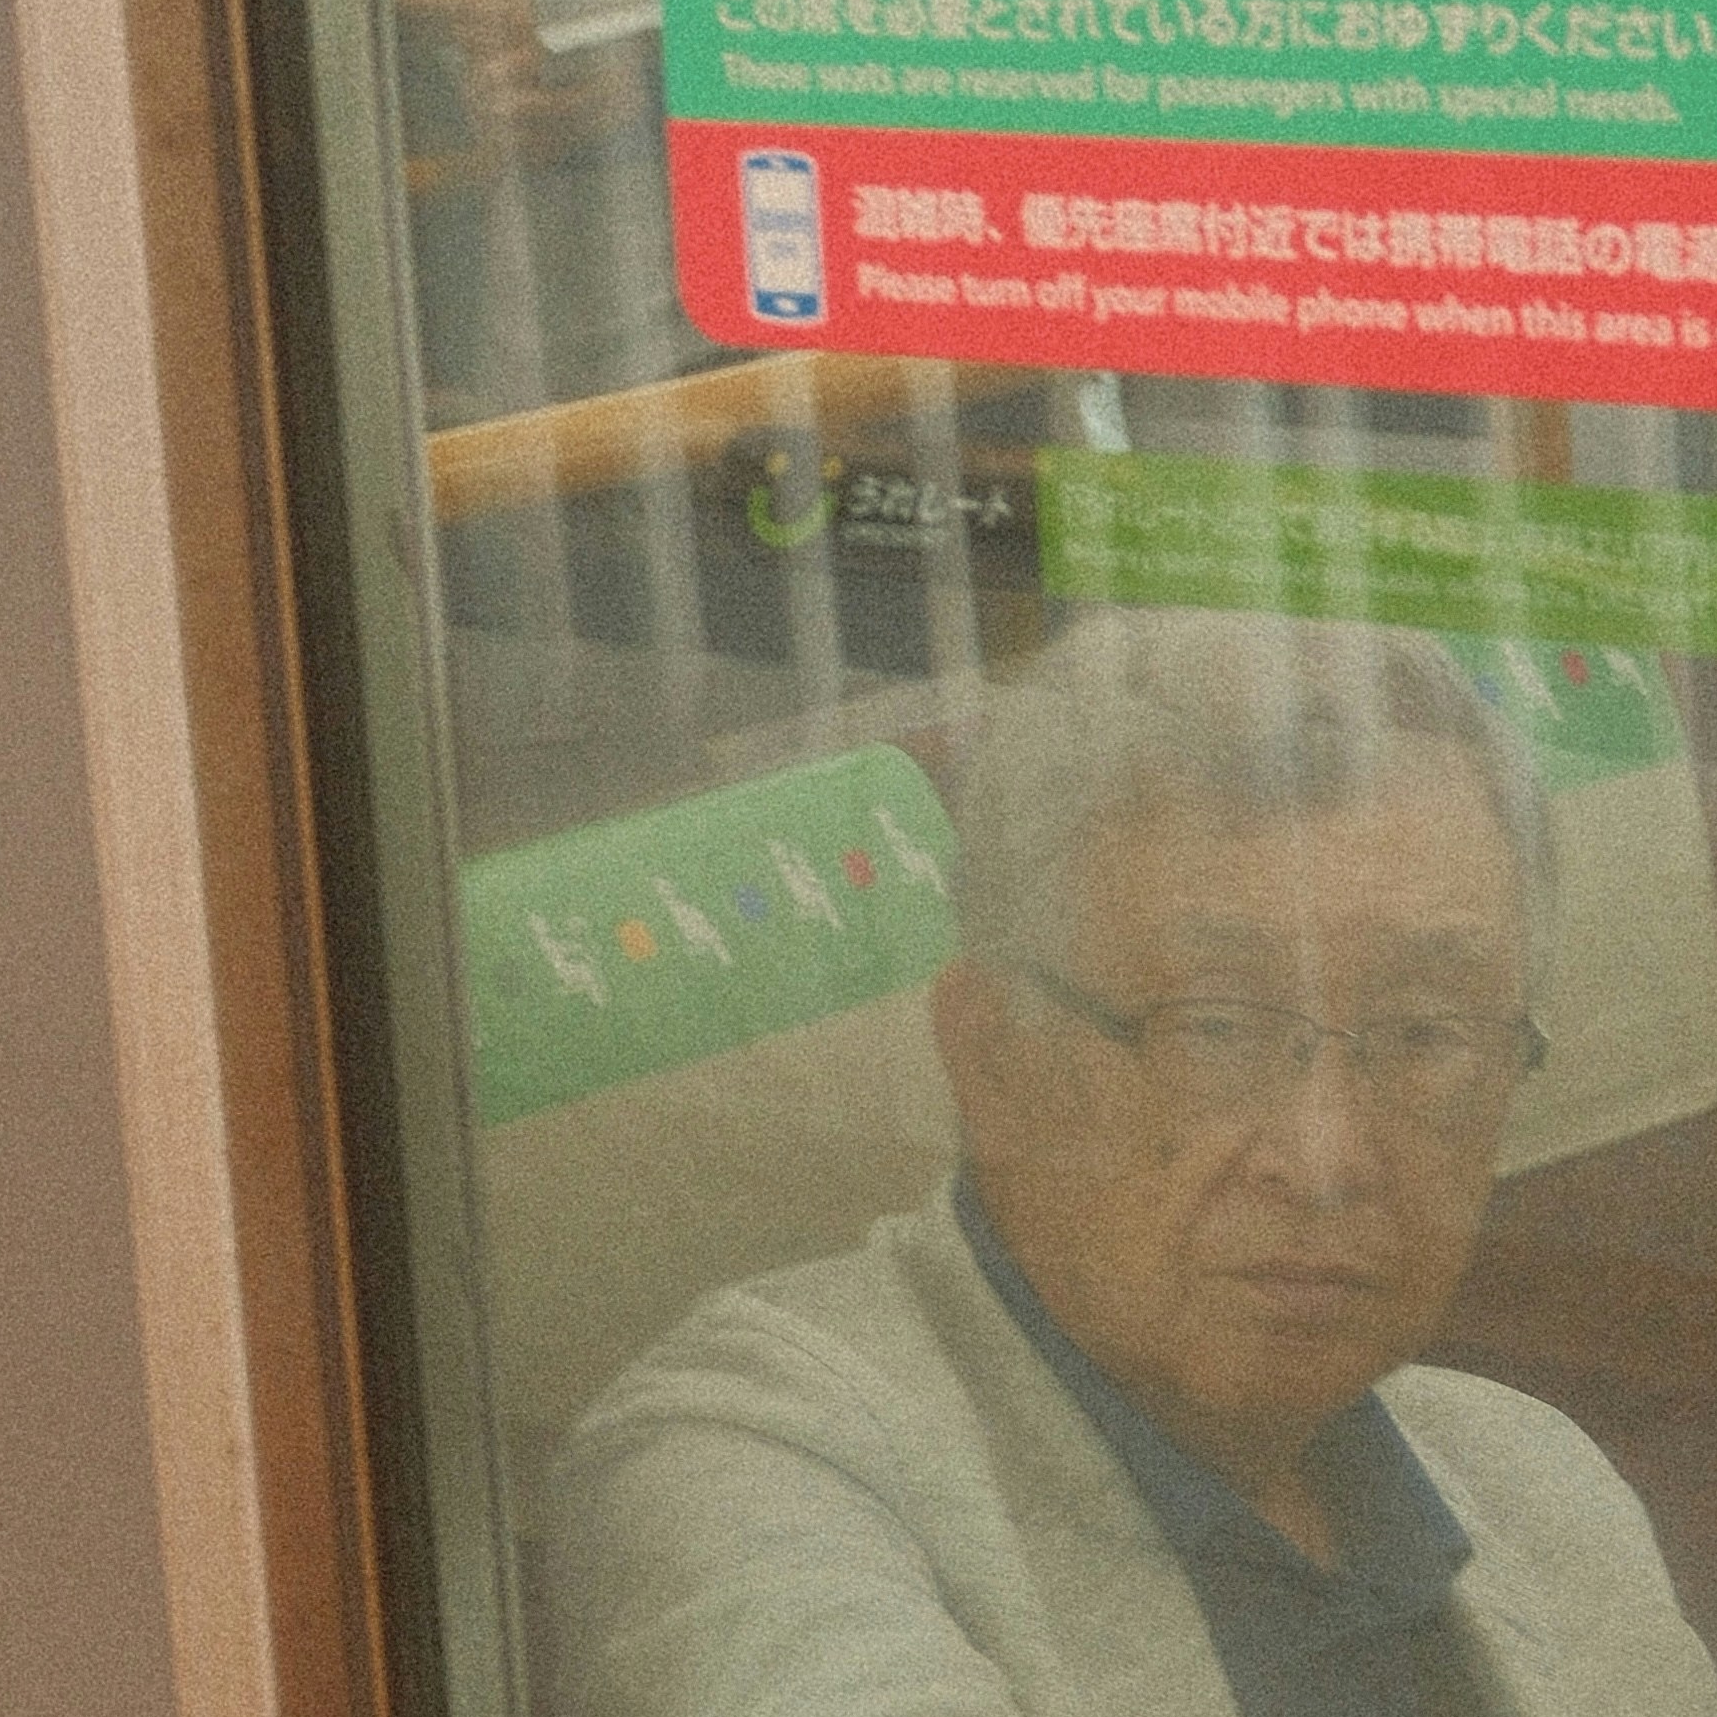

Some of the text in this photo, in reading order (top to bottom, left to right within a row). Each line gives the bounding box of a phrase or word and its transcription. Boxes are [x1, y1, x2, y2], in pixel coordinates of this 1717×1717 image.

[1350, 76, 1431, 112] with
[857, 262, 959, 304] Please
[959, 273, 1033, 307] turn
[1088, 285, 1169, 322] your
[1172, 282, 1292, 325] mobile
[1296, 287, 1410, 333] phone
[1412, 295, 1515, 336] when
[1520, 300, 1589, 342] this
[1592, 312, 1674, 347] area
[1680, 311, 1712, 348] is
